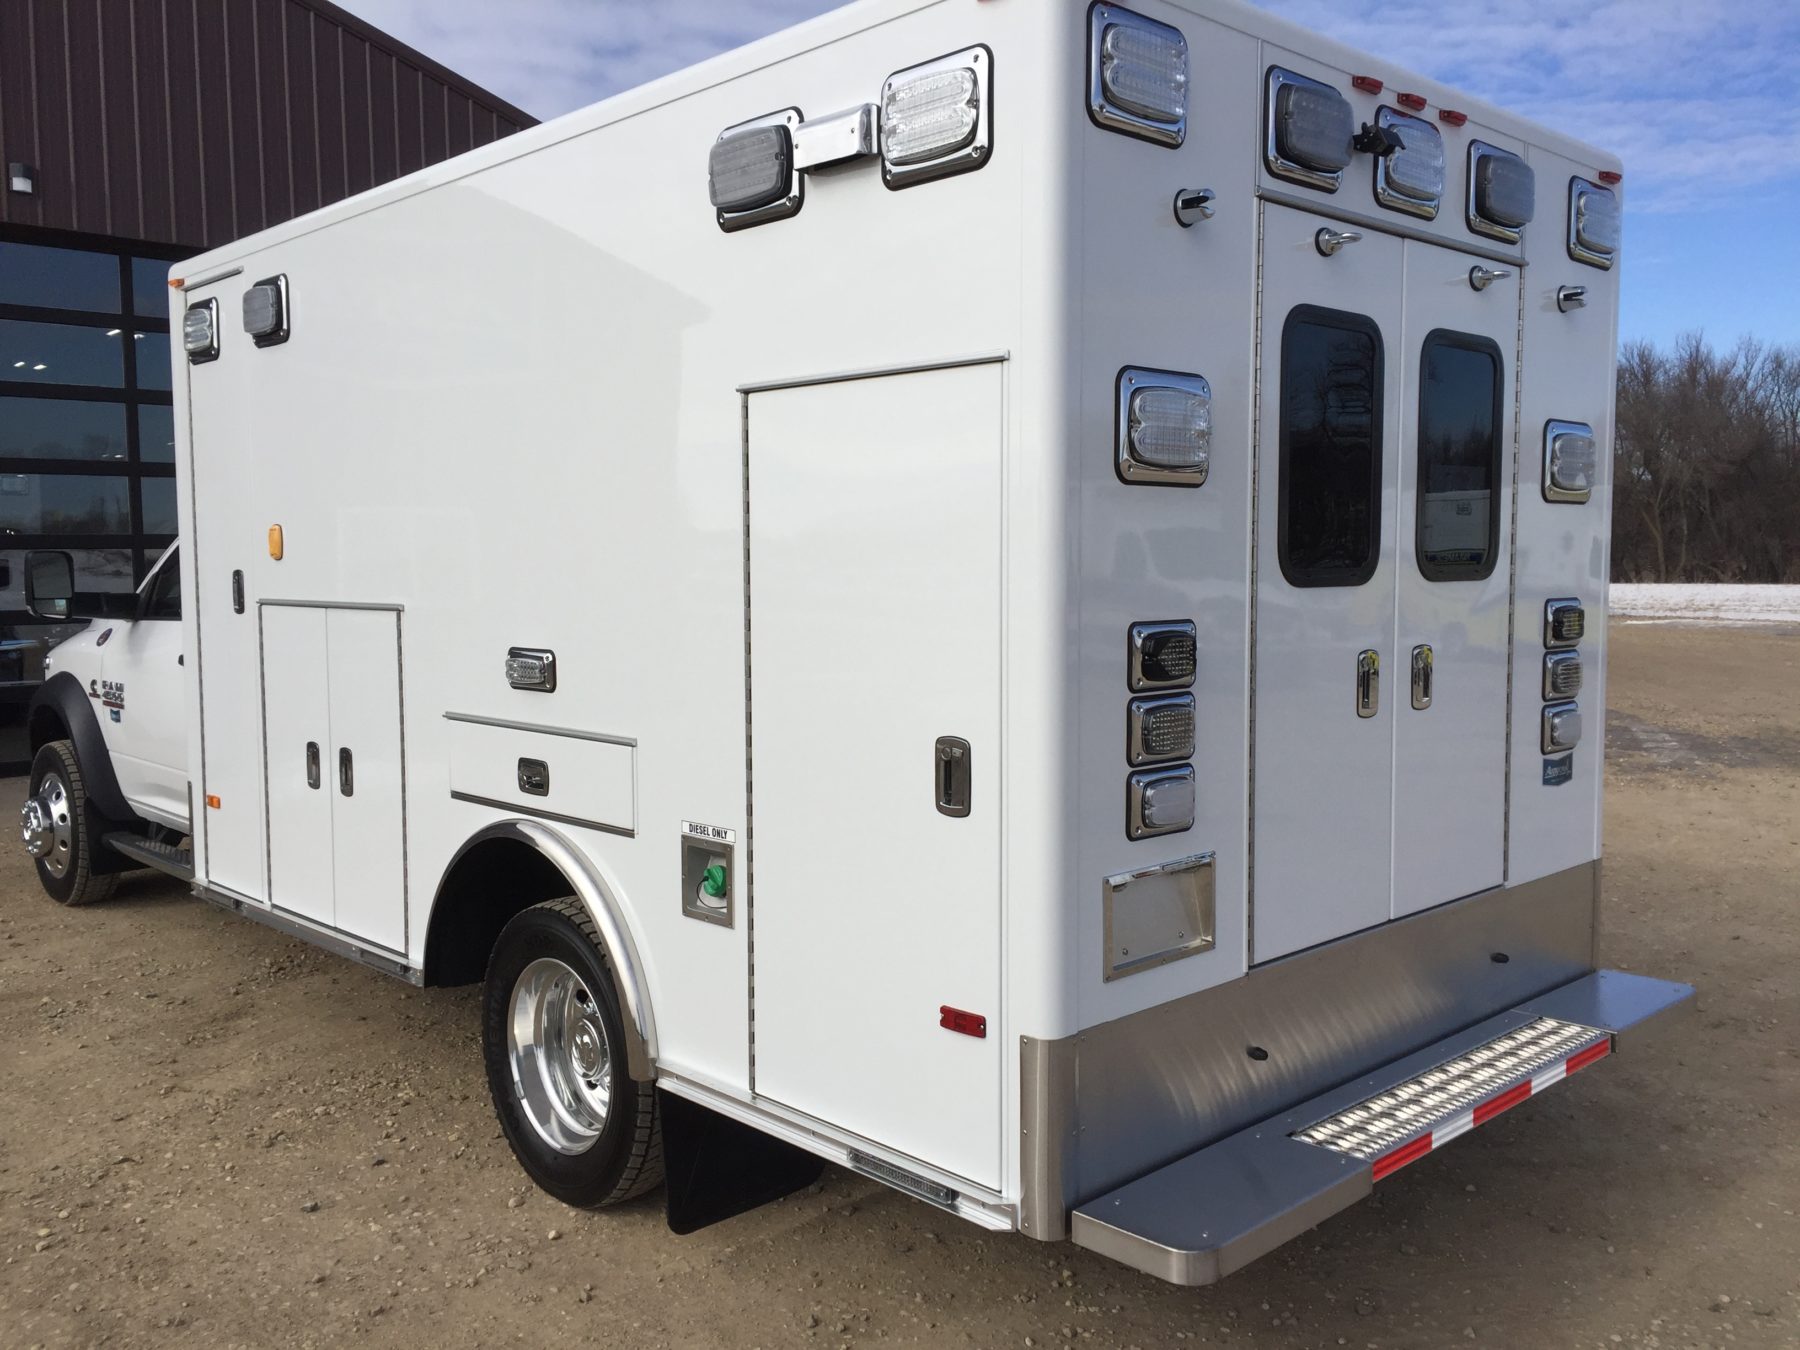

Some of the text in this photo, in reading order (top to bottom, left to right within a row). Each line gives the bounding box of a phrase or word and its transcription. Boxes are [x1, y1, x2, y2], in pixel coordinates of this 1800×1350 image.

[102, 680, 125, 693] RAM
[688, 823, 728, 840] DIESEL ONLY
